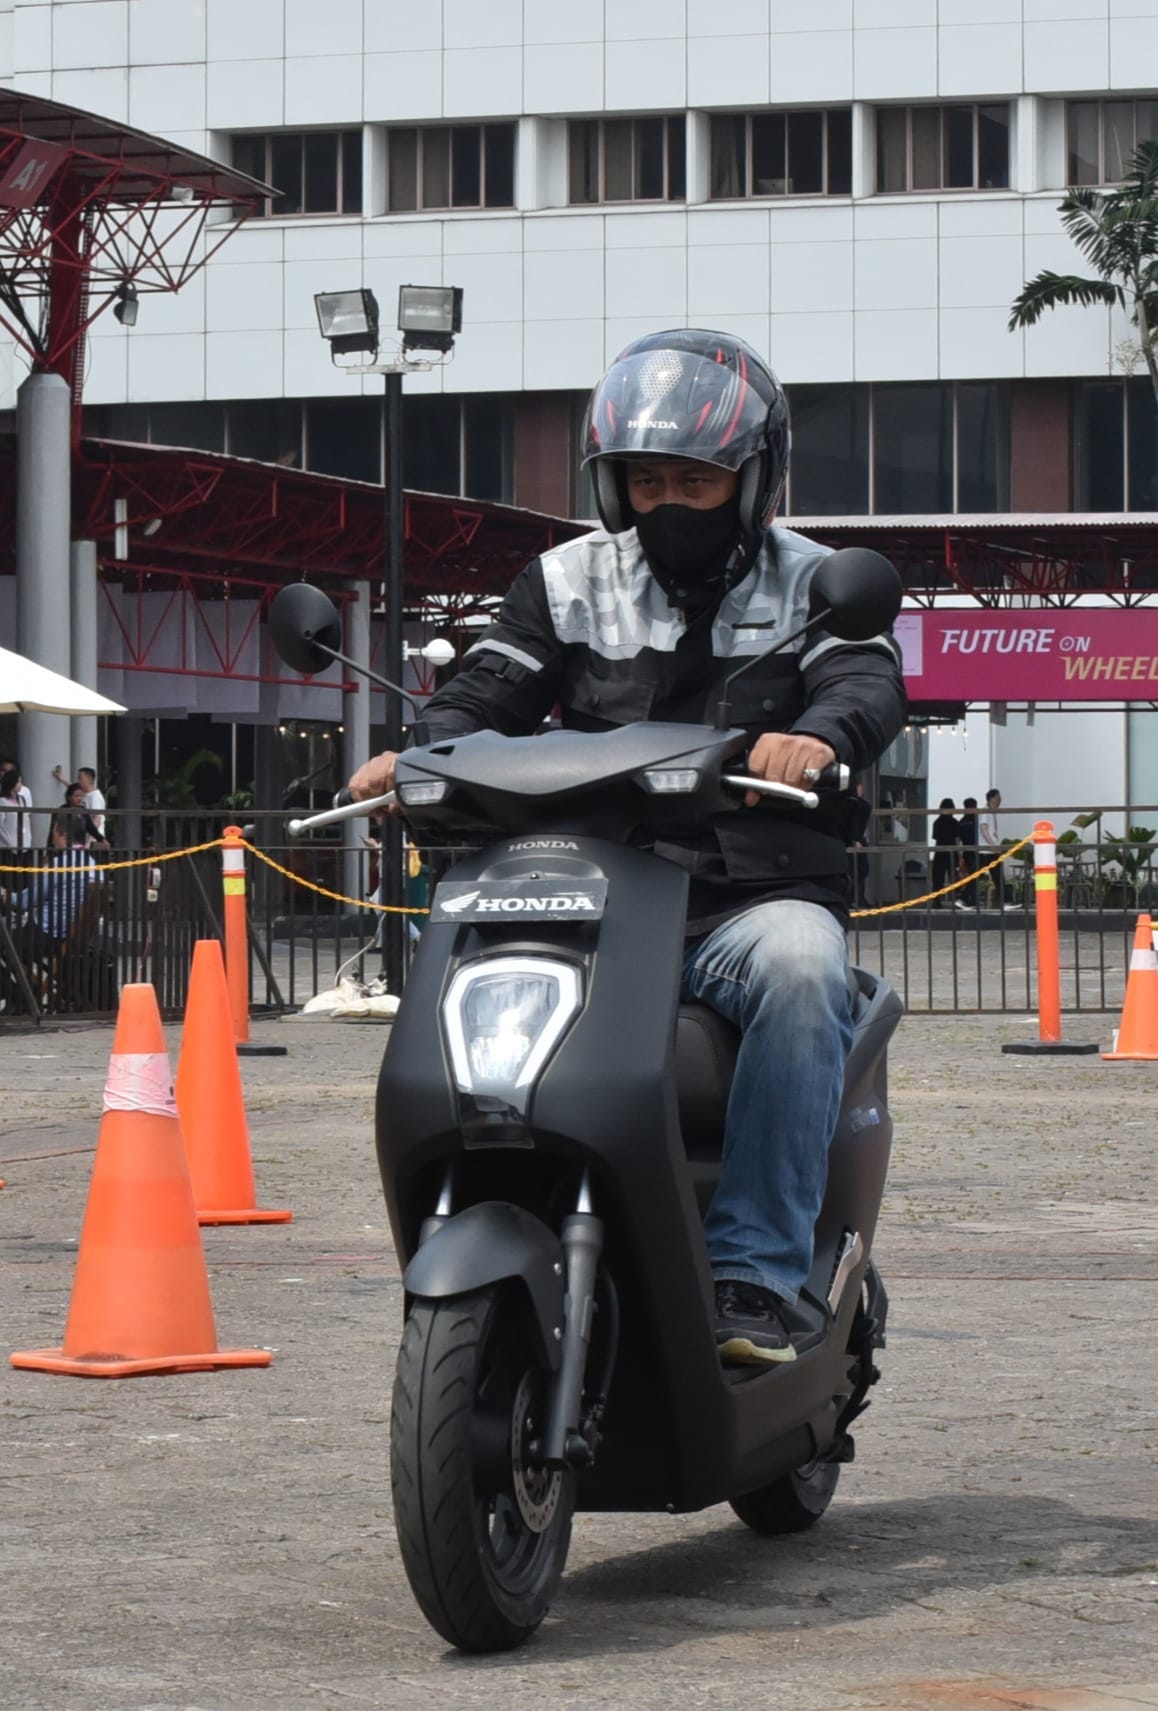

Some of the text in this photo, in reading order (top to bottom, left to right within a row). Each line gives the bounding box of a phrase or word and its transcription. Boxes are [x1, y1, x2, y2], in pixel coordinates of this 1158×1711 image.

[8, 159, 48, 192] A1
[627, 420, 679, 430] HONDA
[939, 629, 1091, 653] FUTURE ON
[1059, 656, 1158, 680] WHEEL
[508, 840, 580, 852] HONDA
[475, 897, 596, 912] HONDA
